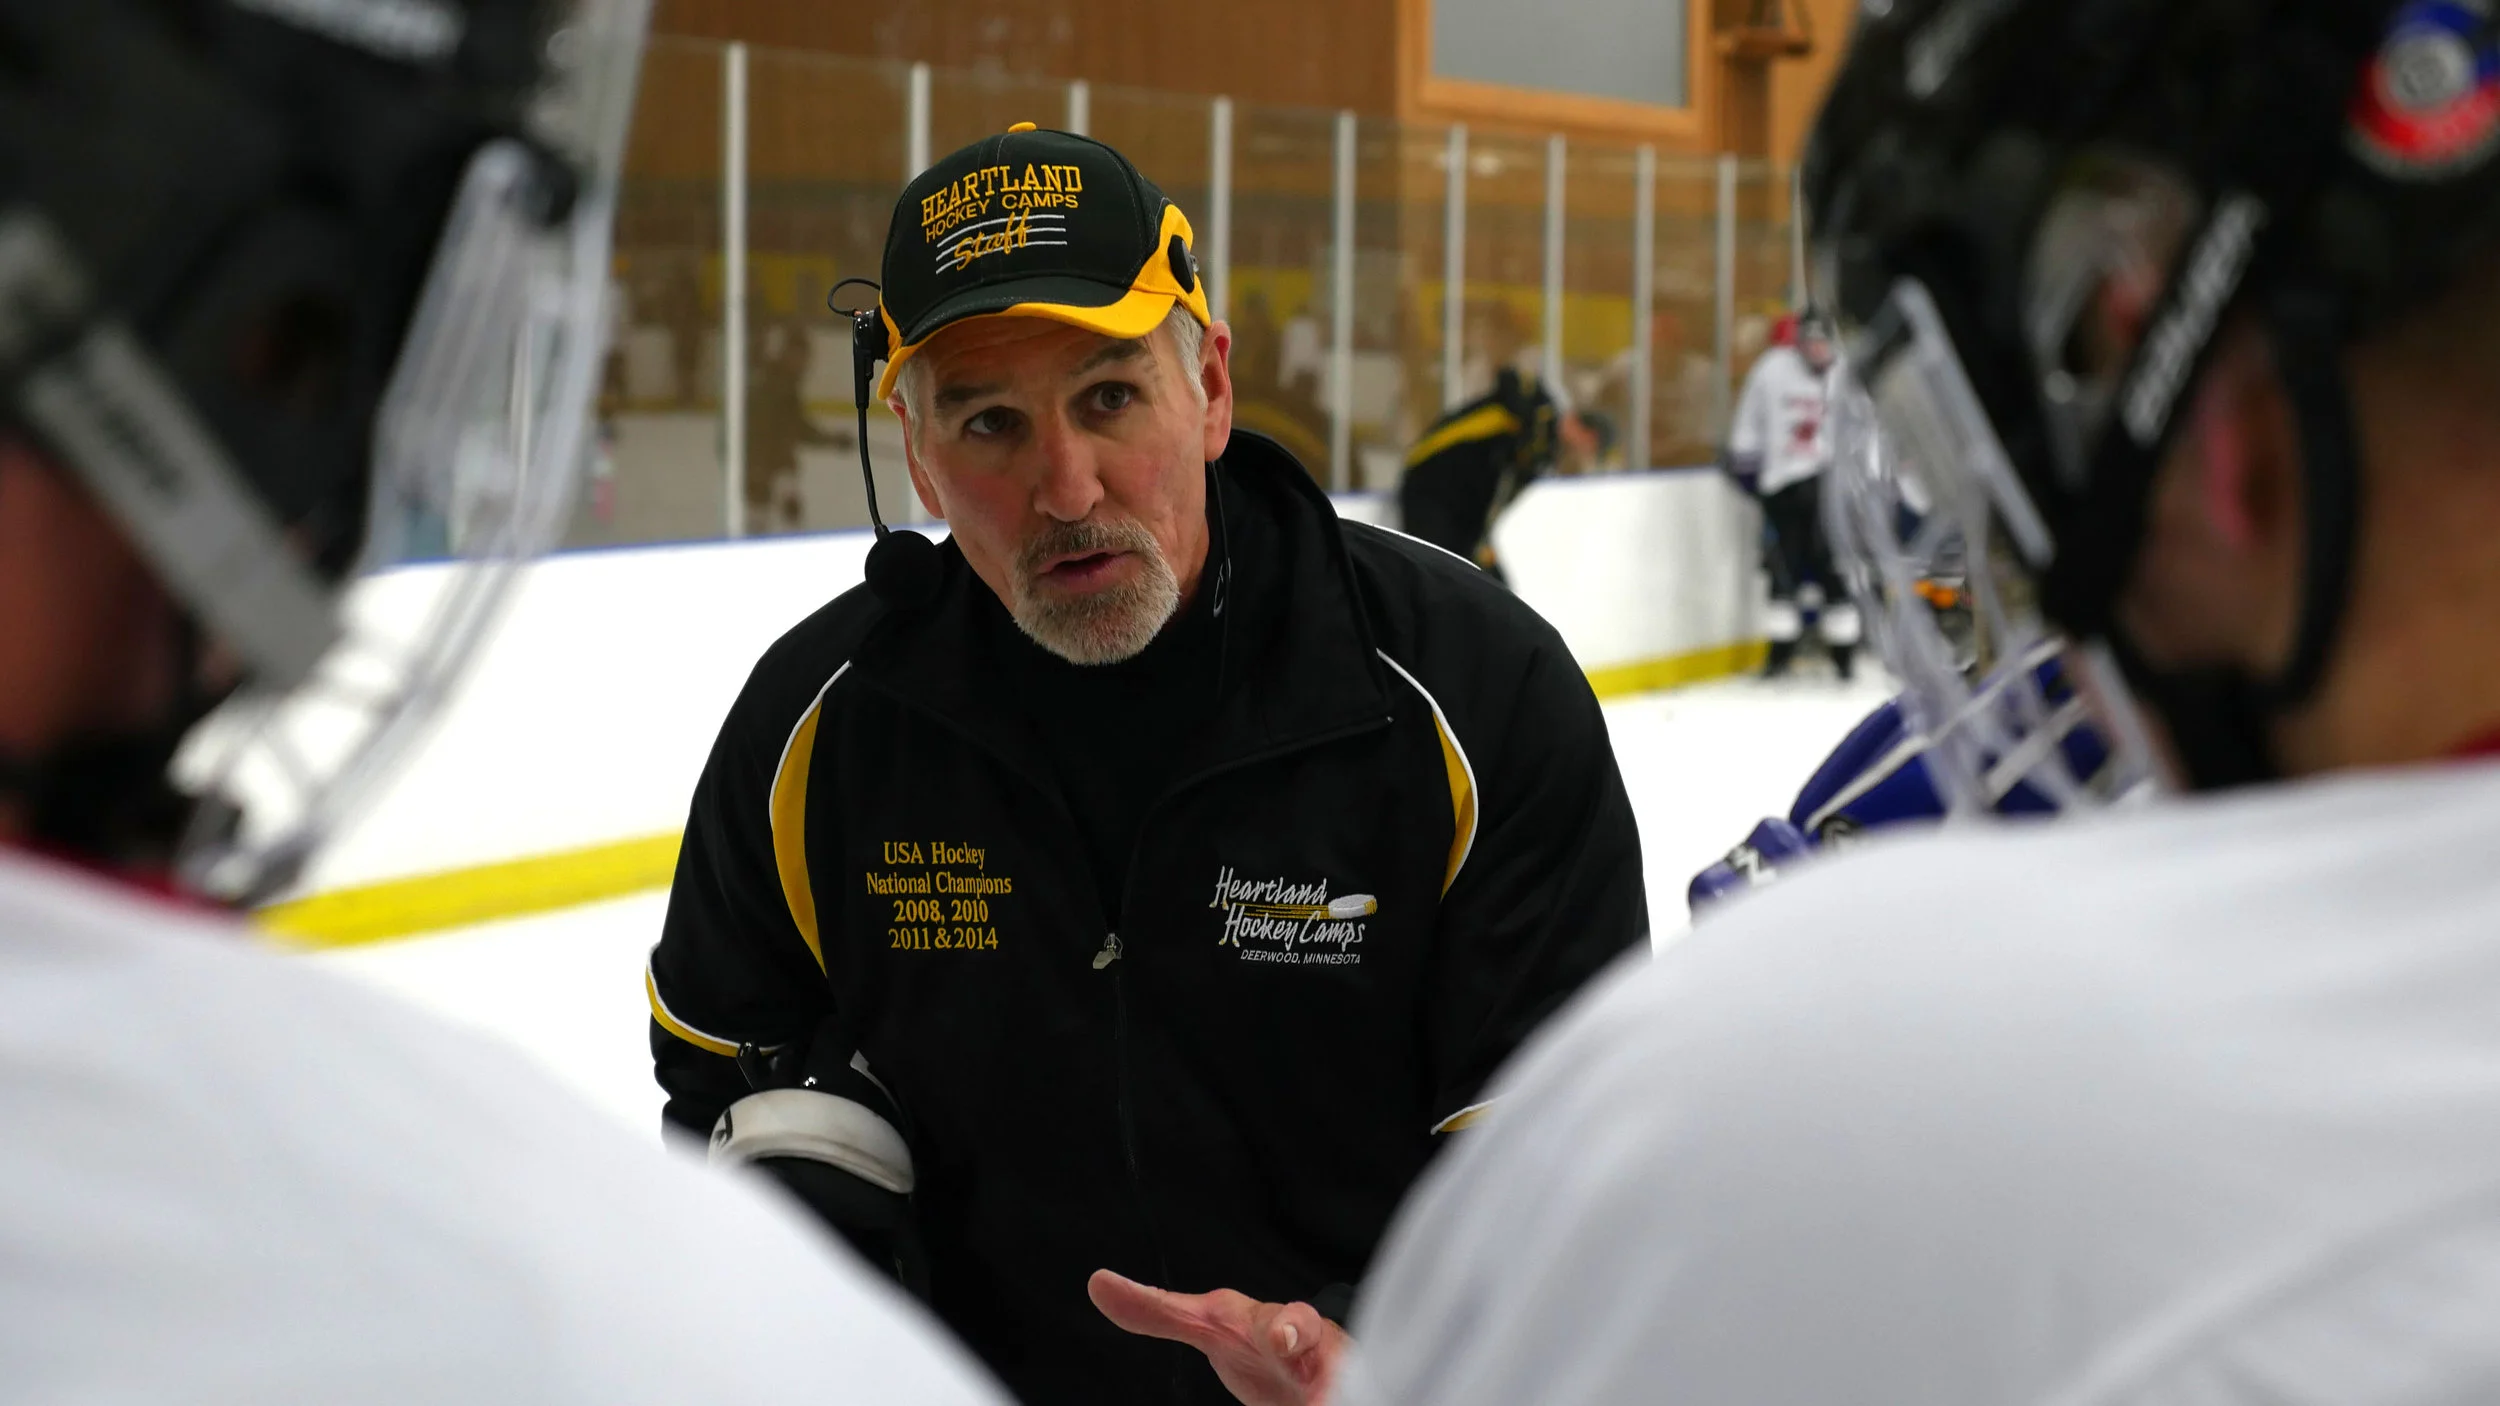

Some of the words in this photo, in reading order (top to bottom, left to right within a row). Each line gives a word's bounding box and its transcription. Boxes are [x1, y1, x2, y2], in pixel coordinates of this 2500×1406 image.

[921, 163, 1083, 226] HEARTLAND
[926, 199, 990, 243] HOCKEY
[1001, 193, 1079, 209] CAMPS
[954, 207, 1032, 271] Staff
[884, 841, 924, 864] USA
[931, 841, 985, 870] Hockey
[866, 872, 931, 894] National
[935, 871, 1012, 899] Champions
[1208, 865, 1327, 911] Heartland
[893, 899, 945, 925] 2008,
[951, 899, 989, 923] 2010
[1218, 902, 1299, 951] Hockey
[1300, 910, 1366, 952] Camps
[888, 927, 931, 950] 2011
[934, 927, 952, 949] &
[954, 927, 998, 950] 2014
[1240, 949, 1301, 964] DEERWOOD,
[1303, 952, 1361, 965] MINNESOTA
